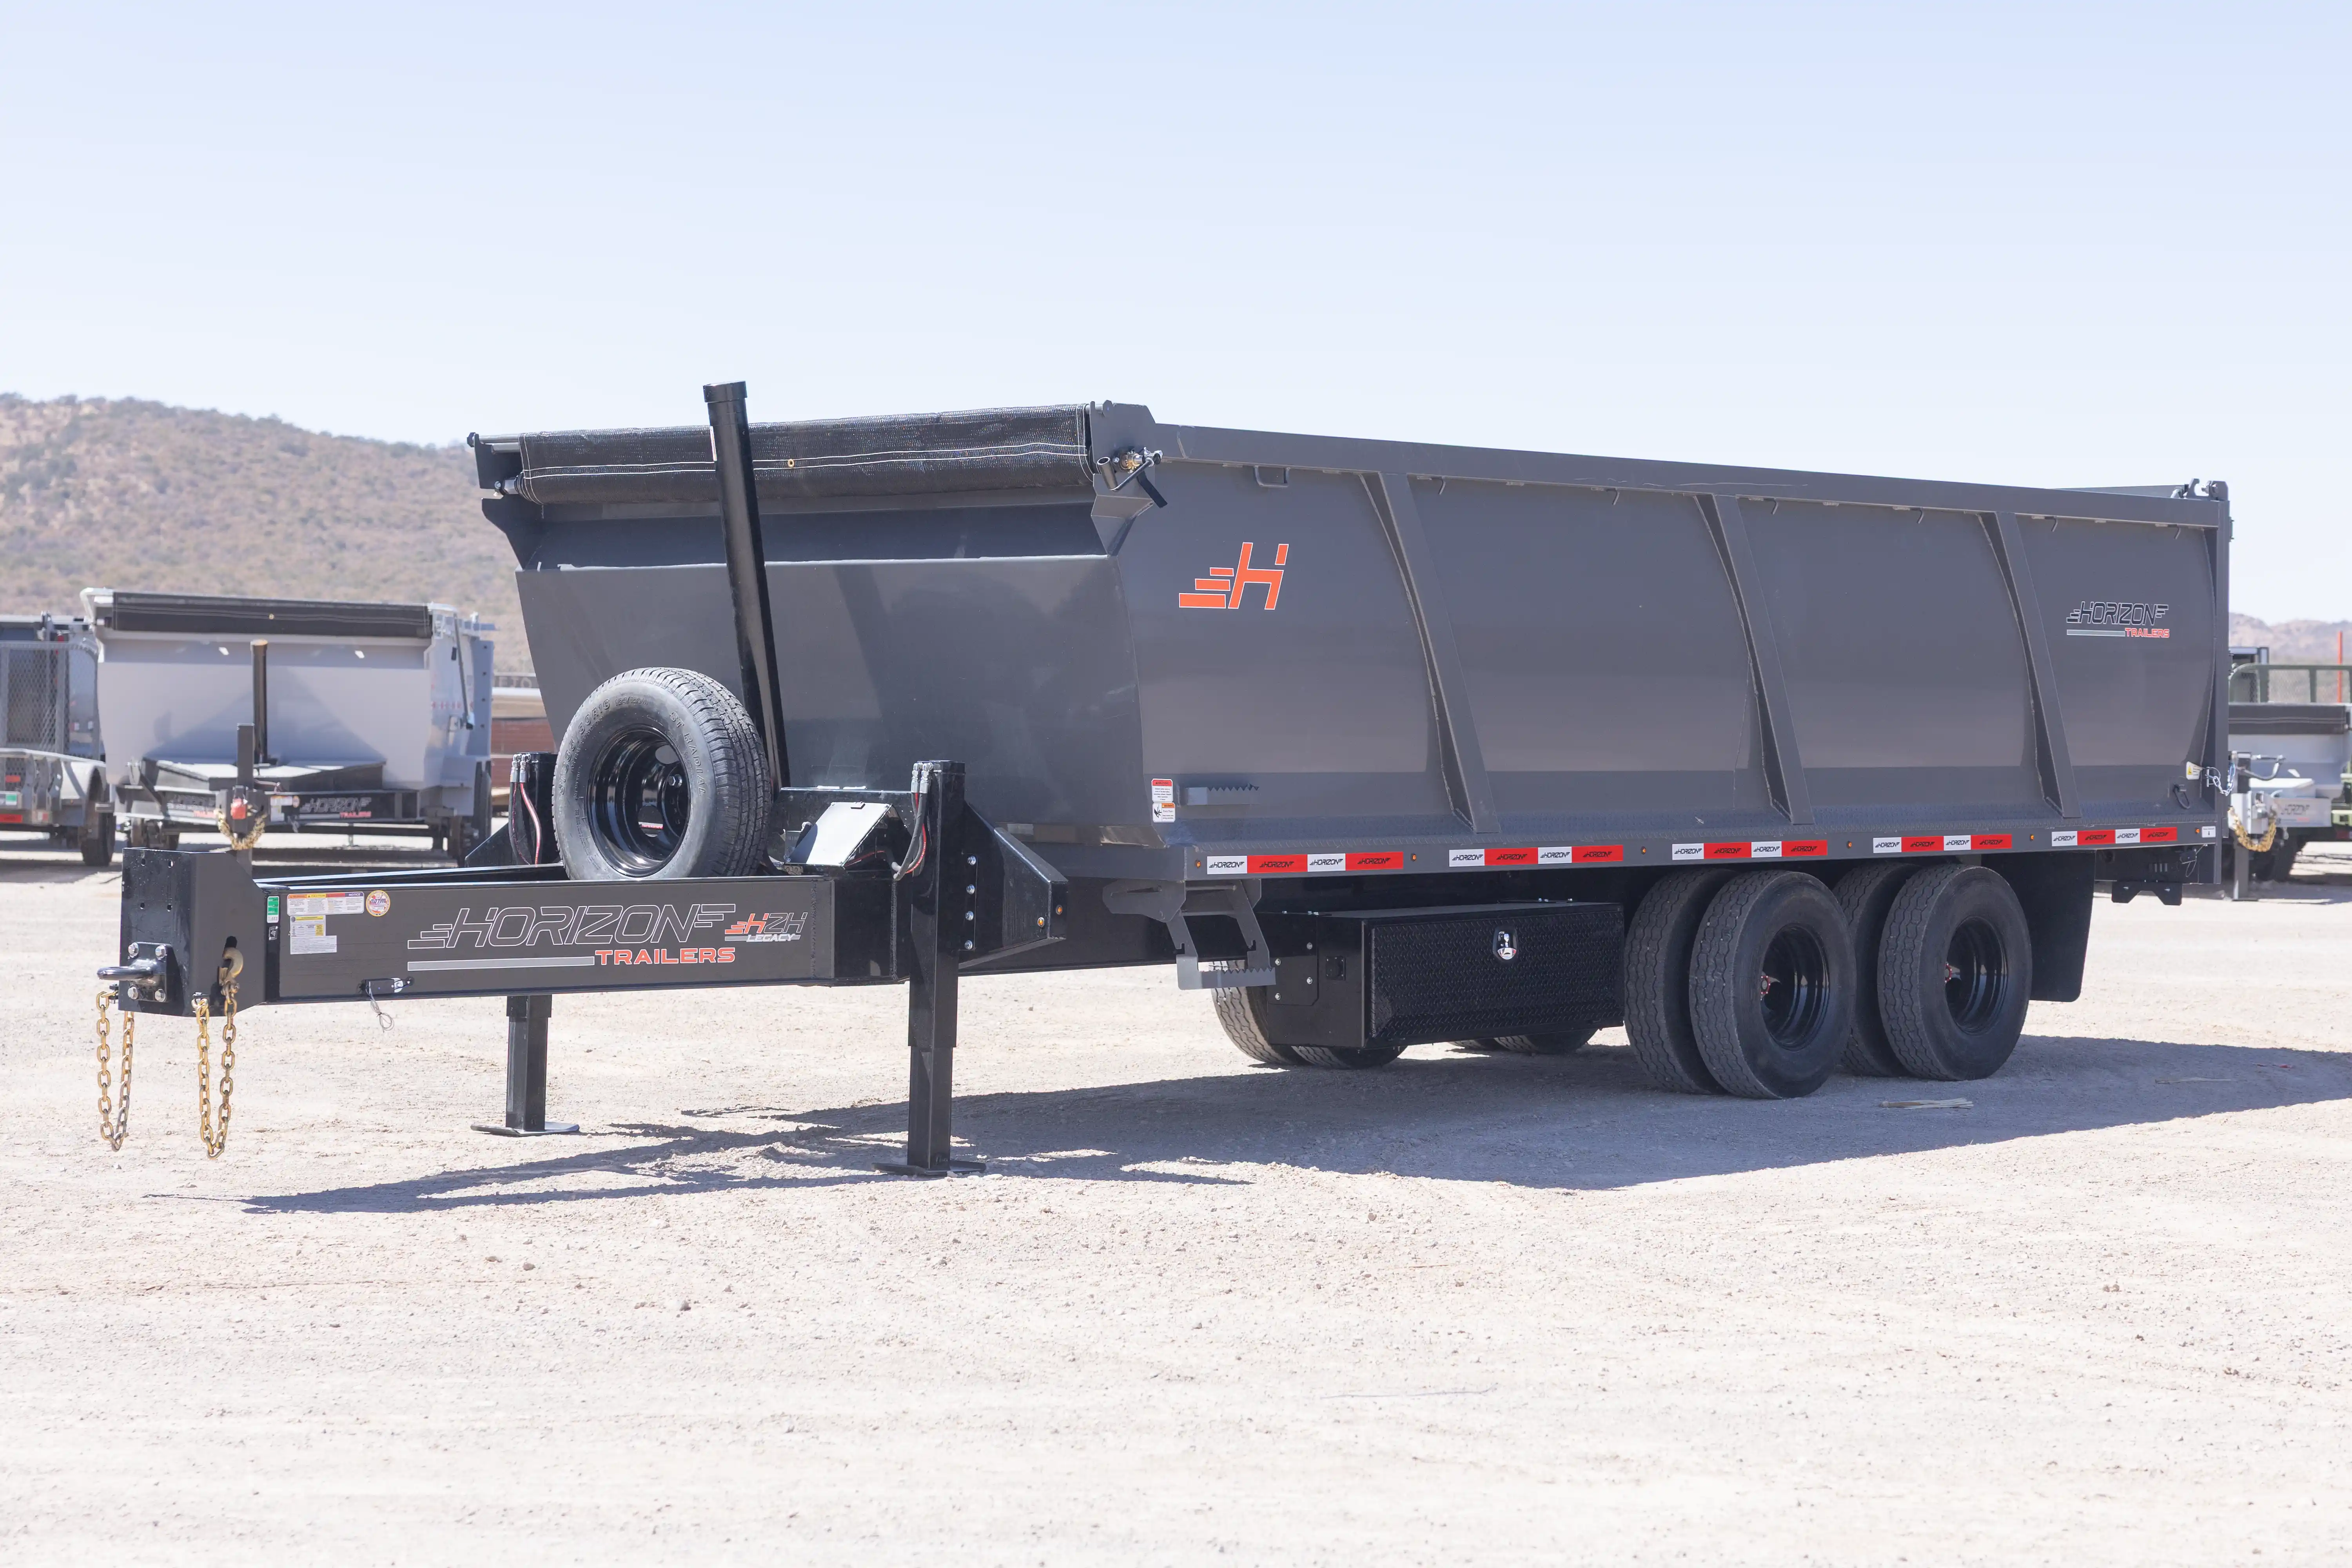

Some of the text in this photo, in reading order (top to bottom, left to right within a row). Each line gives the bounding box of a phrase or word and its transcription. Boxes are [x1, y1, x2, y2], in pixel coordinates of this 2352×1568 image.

[2079, 601, 2156, 626] HORIZON
[2125, 627, 2170, 638] TRAILERS
[670, 711, 684, 728] ST
[684, 732, 706, 796] RADIAL
[446, 904, 700, 948] HORIZON
[746, 933, 795, 942] LEGACY
[595, 947, 735, 965] TRAILERS
